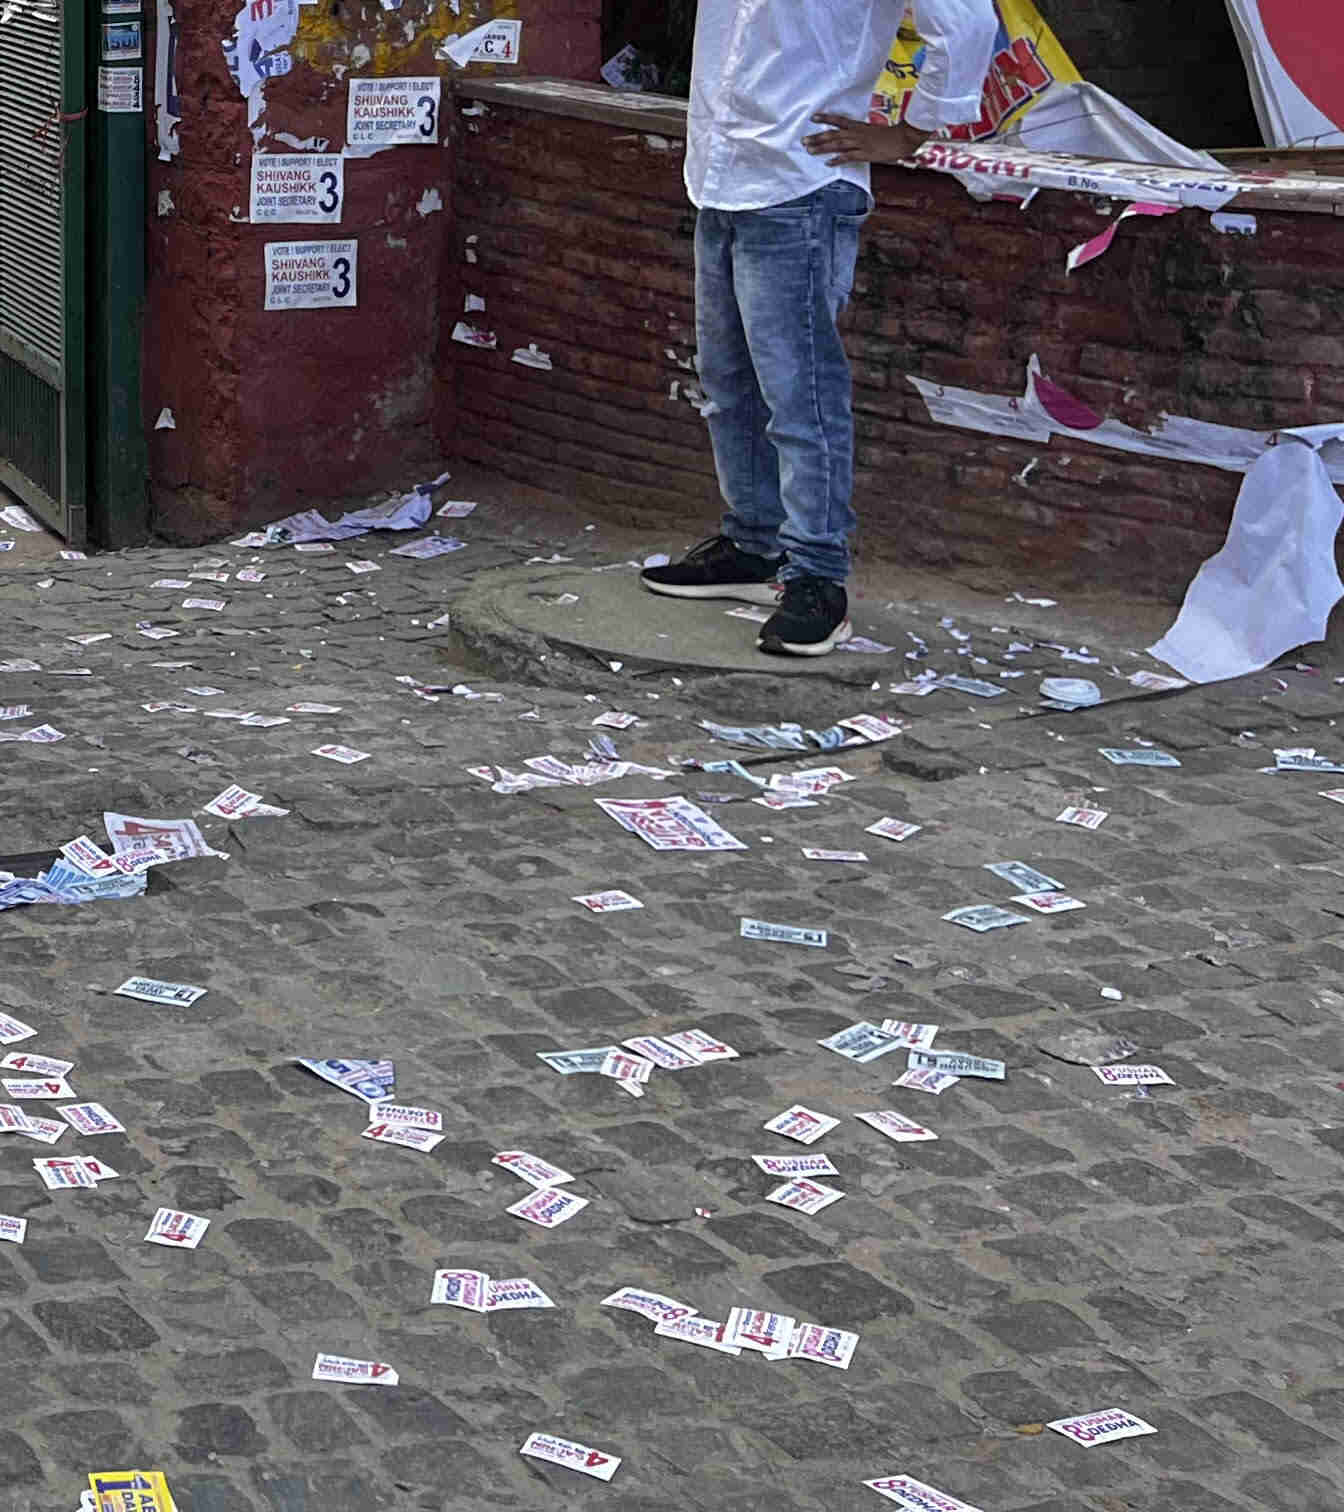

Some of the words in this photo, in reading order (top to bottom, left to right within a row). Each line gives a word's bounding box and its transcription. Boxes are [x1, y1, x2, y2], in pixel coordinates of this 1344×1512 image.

[354, 95, 409, 106] SHIIVANG
[354, 107, 415, 119] KAUSHIKK
[417, 96, 436, 136] 3
[376, 119, 416, 130] SECRETARY
[256, 170, 311, 182] SHIIVANG
[256, 182, 317, 193] KAUSHIKK
[319, 172, 339, 213] 3
[278, 196, 316, 206] SECRETARY
[272, 258, 325, 270] SHIIVANG
[272, 270, 329, 282] KAUSHIKK
[332, 257, 351, 298] 3
[292, 283, 330, 293] SECRETARY
[496, 1291, 542, 1302] DEDHA
[1075, 1412, 1126, 1427] TUSHAR
[1062, 1424, 1095, 1441] 8
[1090, 1418, 1139, 1436] DEDHA
